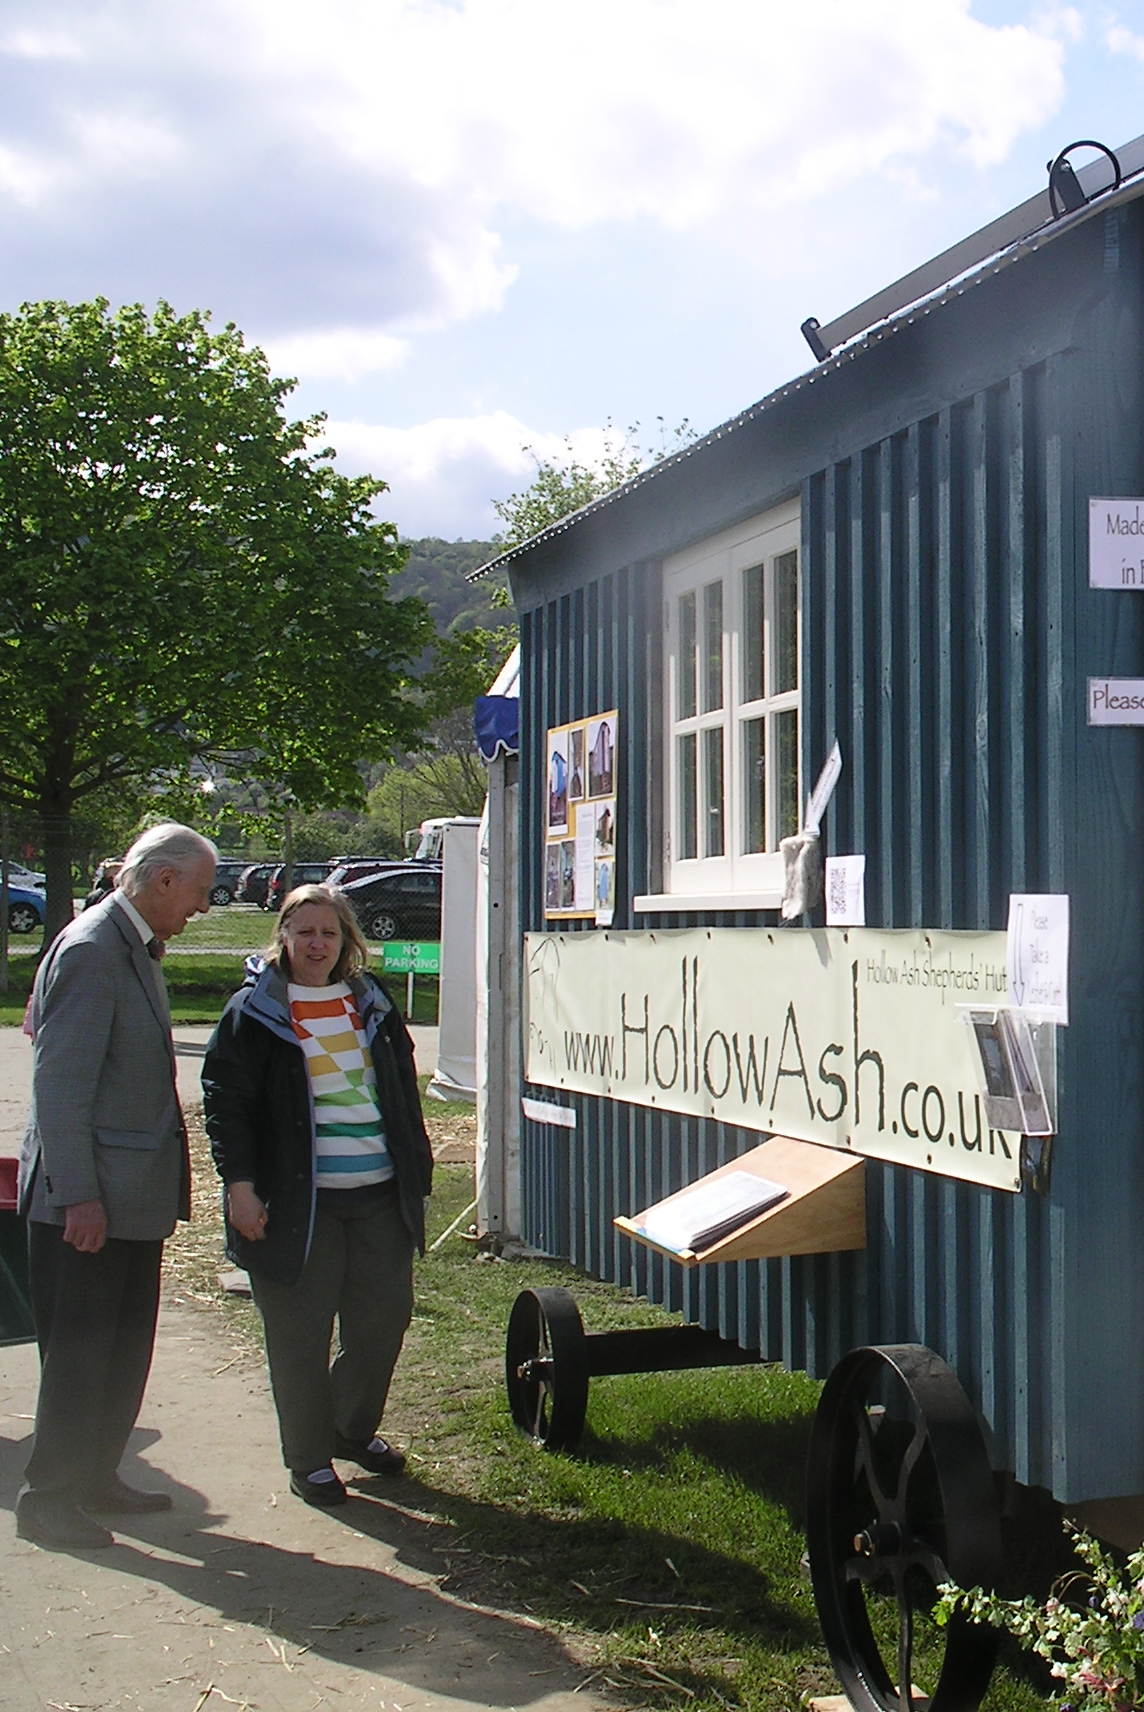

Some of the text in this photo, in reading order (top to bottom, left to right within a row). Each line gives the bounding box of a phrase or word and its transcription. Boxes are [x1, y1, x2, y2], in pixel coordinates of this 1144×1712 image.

[1121, 558, 1136, 584] in
[402, 945, 421, 956] NO
[384, 956, 439, 969] PARKING
[866, 949, 898, 984] Hollow
[900, 949, 920, 986] Ash
